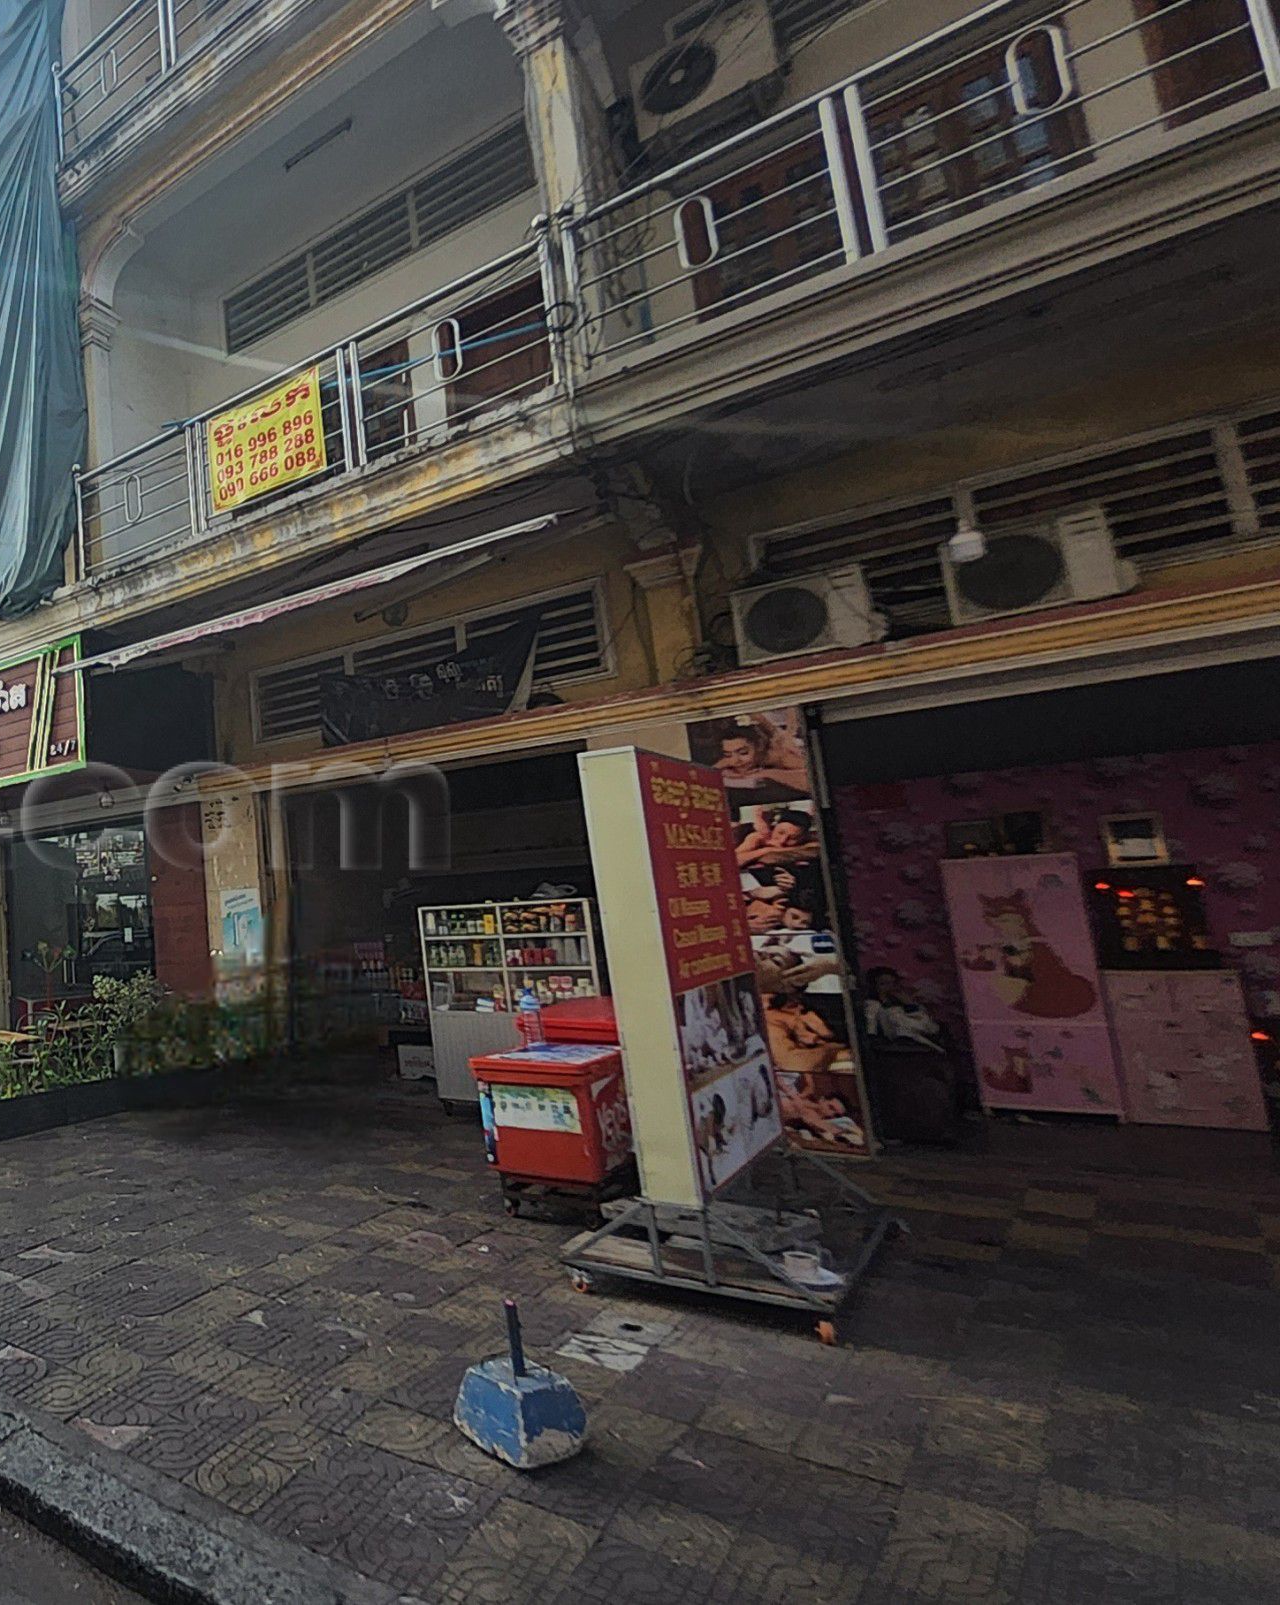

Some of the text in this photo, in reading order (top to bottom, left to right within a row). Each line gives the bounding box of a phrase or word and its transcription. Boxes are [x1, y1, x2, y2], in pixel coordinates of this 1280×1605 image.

[216, 410, 313, 466] 016 996 896
[217, 428, 315, 484] 093 788 288
[249, 462, 279, 486] 666
[284, 446, 316, 471] 088
[50, 739, 76, 756] 24/7
